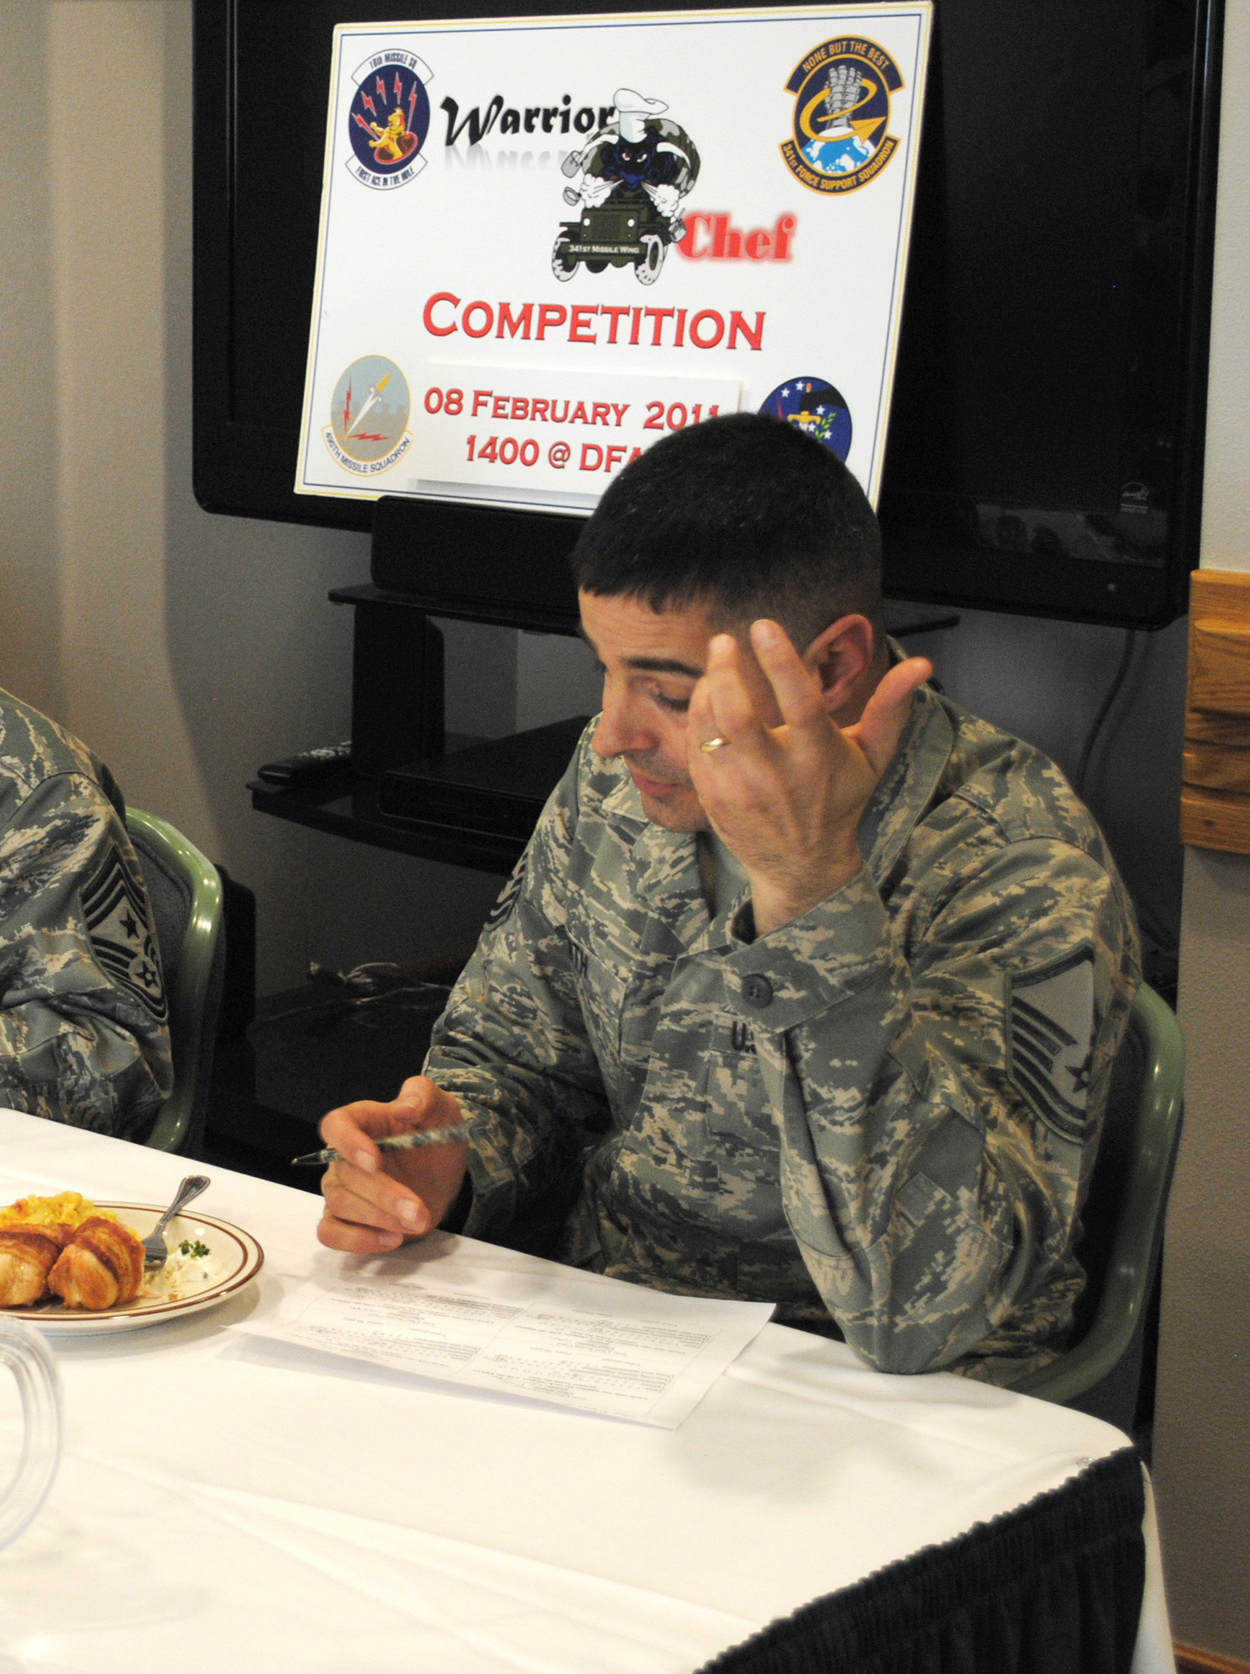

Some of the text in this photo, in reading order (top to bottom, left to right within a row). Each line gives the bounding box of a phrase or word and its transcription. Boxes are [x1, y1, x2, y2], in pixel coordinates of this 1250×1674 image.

[802, 40, 890, 73] NONE BUT THE BEST
[439, 93, 617, 147] Warrior
[796, 165, 819, 187] FORCE
[820, 176, 857, 189] SUPPORT
[859, 140, 894, 182] SQUADRON
[619, 245, 640, 254] WING
[676, 211, 796, 262] Chef
[422, 290, 767, 351] COMPETITION
[423, 387, 464, 416] 08
[470, 389, 630, 427] FEBRUARY
[370, 437, 410, 472] SQUADRON
[466, 434, 540, 466] 1400
[547, 440, 572, 469] @
